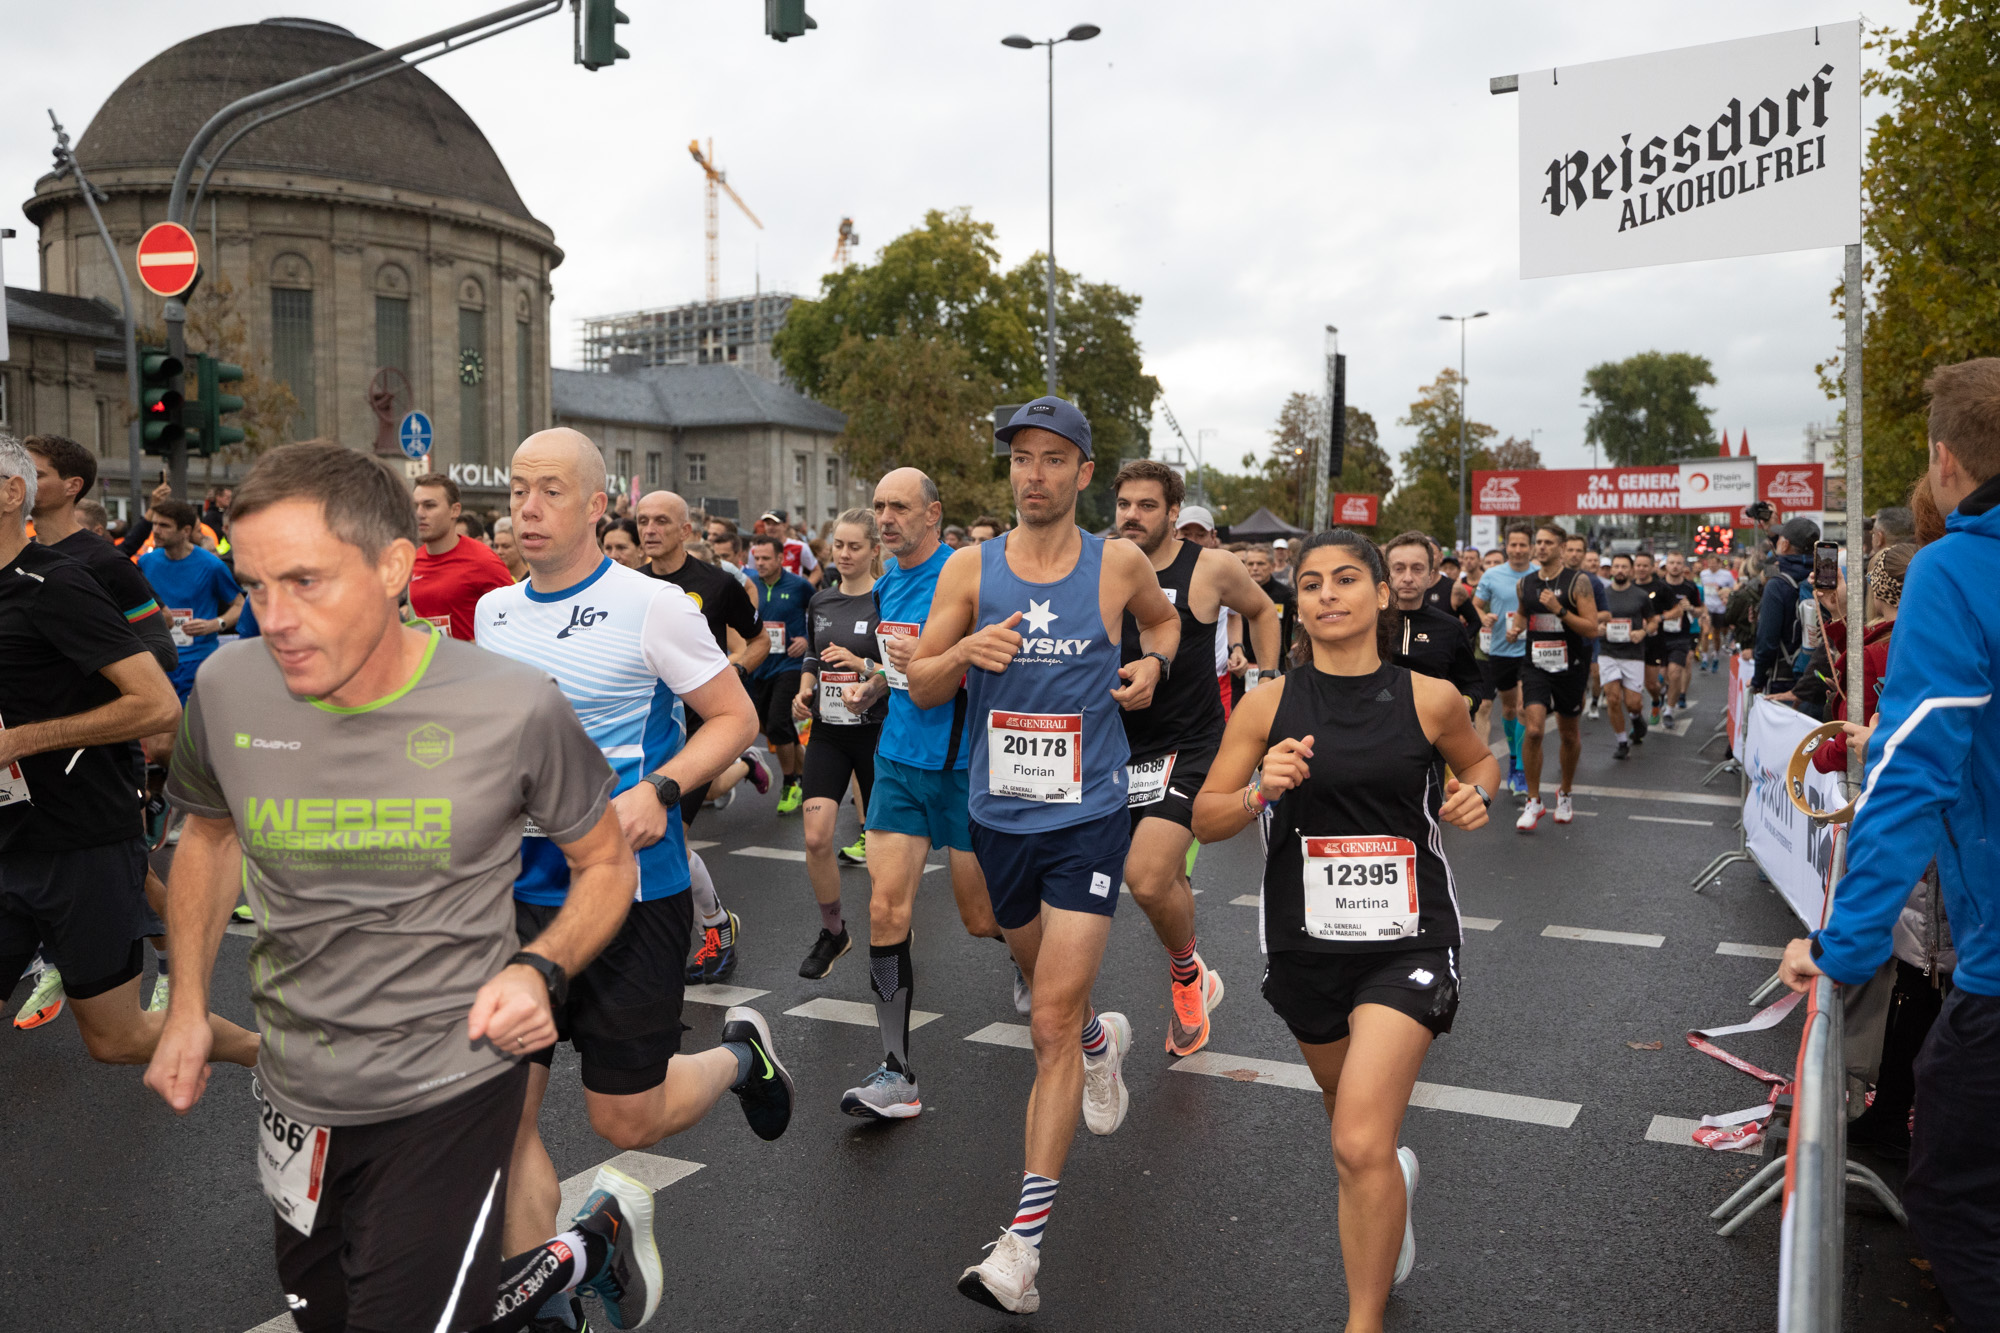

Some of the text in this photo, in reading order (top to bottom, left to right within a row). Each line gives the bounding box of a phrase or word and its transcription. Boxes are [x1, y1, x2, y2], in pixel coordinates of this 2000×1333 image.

[1541, 63, 1835, 217] Reissdorf
[1618, 134, 1826, 233] ALKOHOLFREI
[449, 463, 510, 487] KÖLN
[1713, 472, 1741, 482] Rhein
[1588, 475, 1613, 490] 24.
[1713, 481, 1751, 491] Energie
[1480, 501, 1521, 511] GENERALI
[1577, 491, 1618, 510] KÖLN
[1017, 638, 1092, 655] YSKY
[1013, 656, 1063, 666] copenhagen
[1019, 719, 1067, 729] GENERALI
[1003, 735, 1067, 757] 20178
[1013, 764, 1055, 777] Florian
[1010, 785, 1033, 793] GENERALI
[248, 797, 453, 832] WEBER
[251, 831, 452, 850] ASSEKURANZ
[1341, 841, 1397, 853] GENERALI
[1323, 863, 1398, 886] 12395
[1335, 897, 1389, 909] Martina
[1378, 928, 1401, 936] PUMA
